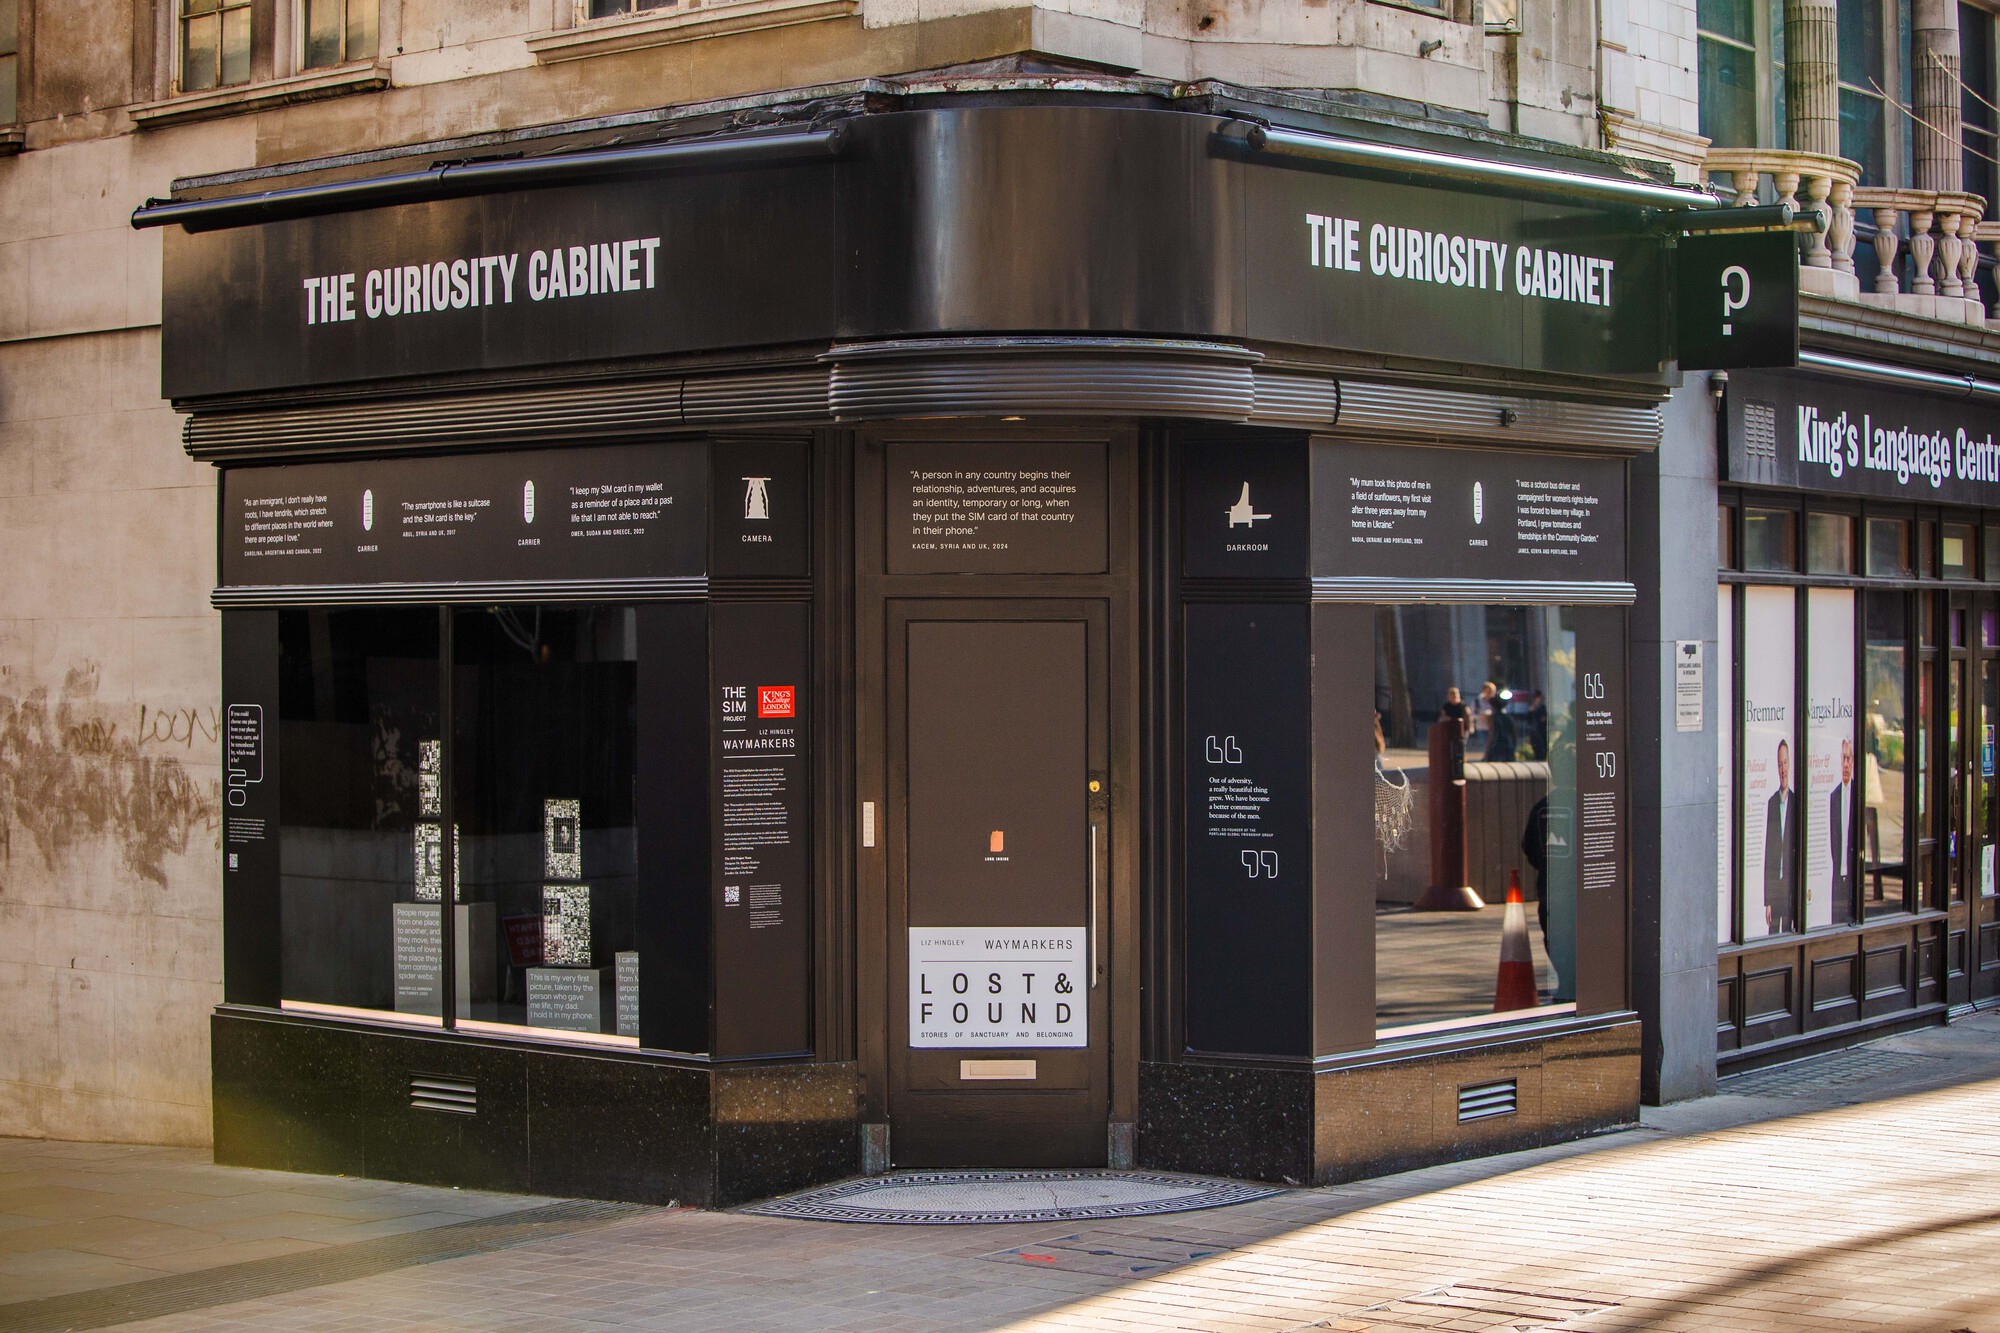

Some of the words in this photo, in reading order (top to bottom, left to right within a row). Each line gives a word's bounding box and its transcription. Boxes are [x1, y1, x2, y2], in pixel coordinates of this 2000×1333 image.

[1306, 213, 1360, 273] THE
[1369, 223, 1507, 292] CURIOSITY
[1516, 246, 1614, 307] CABINET
[304, 274, 355, 325] THE
[365, 254, 518, 319] CURIOSITY
[528, 237, 660, 301] CABINET
[1721, 265, 1750, 335] ?
[1799, 405, 1859, 478] King's
[1864, 414, 1950, 488] Language
[984, 471, 1017, 481] country
[1020, 471, 1049, 481] begins
[576, 486, 590, 496] keep
[601, 486, 613, 494] SIM
[614, 485, 627, 493] card
[645, 484, 663, 492] wallet
[913, 485, 965, 495] relationship,
[967, 485, 1018, 494] adventures,
[1039, 485, 1077, 495] acquires
[415, 501, 447, 512] smartphone
[448, 501, 452, 509] is
[453, 500, 463, 508] like
[468, 499, 491, 508] suitcase
[585, 500, 611, 508] reminder
[611, 499, 618, 507] of
[624, 498, 641, 508] place
[642, 498, 653, 506] and
[660, 497, 673, 507] past
[926, 499, 960, 509] identity,
[963, 499, 1008, 509] temporary
[1022, 499, 1043, 509] long,
[1046, 499, 1070, 507] when
[403, 515, 413, 523] and
[414, 515, 423, 523] the
[424, 514, 435, 523] SIM
[435, 514, 448, 522] card
[449, 514, 454, 522] is
[454, 514, 464, 522] the
[608, 513, 618, 521] not
[618, 512, 632, 521] able
[913, 512, 932, 522] they
[935, 512, 949, 522] put
[952, 512, 966, 521] the
[968, 512, 985, 521] SIM
[988, 512, 1008, 521] card
[1010, 512, 1019, 521] of
[1022, 512, 1039, 521] that
[1041, 512, 1075, 522] country
[913, 526, 921, 535] in
[923, 526, 943, 535] their
[722, 687, 746, 698] THE
[763, 691, 790, 703] KING'S
[722, 701, 746, 713] SIM
[1747, 700, 1785, 722] Bremner
[1832, 698, 1852, 718] Llosa
[723, 739, 795, 749] WAYMARKERS
[1228, 777, 1253, 786] adversity,
[985, 940, 1073, 950] WAYMARKERS
[530, 983, 554, 992] picture,
[573, 984, 582, 993] by
[921, 973, 1035, 994] LOST
[1055, 973, 1073, 994] &
[572, 1012, 594, 1021] phone.
[921, 1003, 1071, 1024] FOUND
